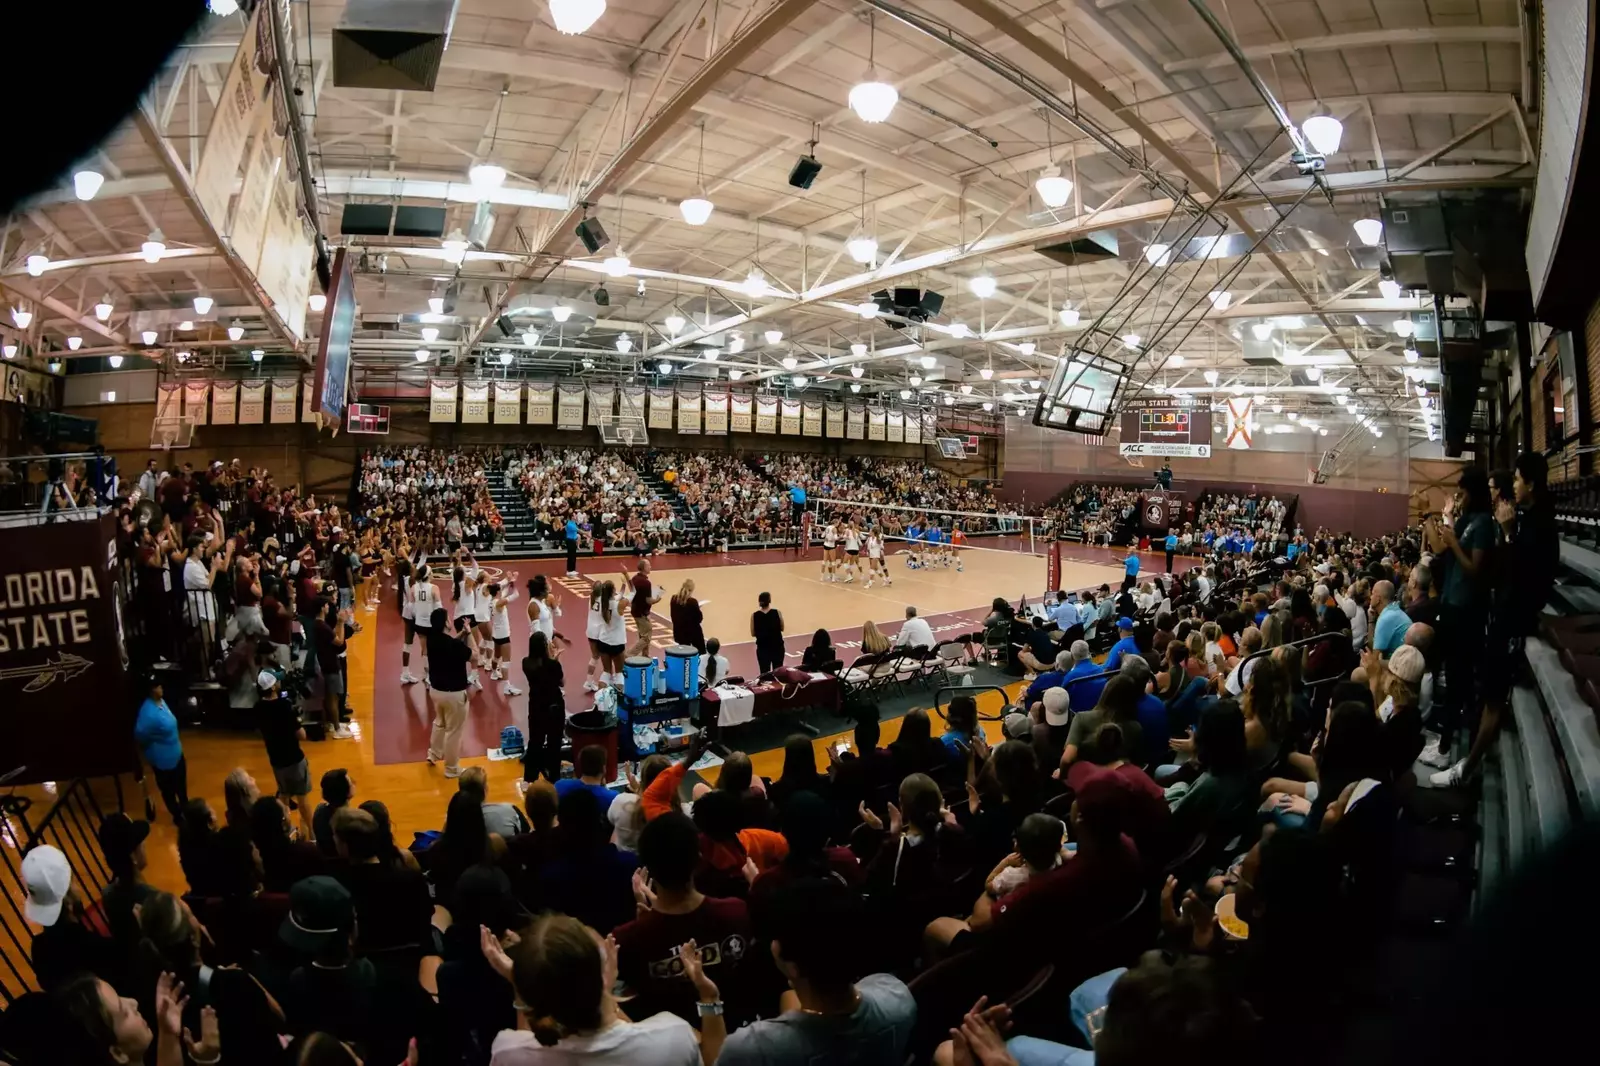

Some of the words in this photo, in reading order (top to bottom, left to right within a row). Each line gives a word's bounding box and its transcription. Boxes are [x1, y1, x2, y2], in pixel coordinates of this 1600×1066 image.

[1148, 399, 1169, 407] STATE
[1170, 399, 1209, 407] VOLLEYBALL
[434, 404, 453, 415] 1990
[466, 405, 485, 416] 1992
[498, 406, 517, 417] 1993
[531, 407, 549, 417] 1997
[652, 412, 669, 422] 2010
[708, 415, 724, 425] 2012
[734, 417, 749, 426] 2013
[759, 418, 773, 427] 2014
[871, 425, 883, 435] 2019
[418, 590, 427, 601] 10
[0, 608, 92, 653] STATE
[653, 946, 717, 977] GOD
